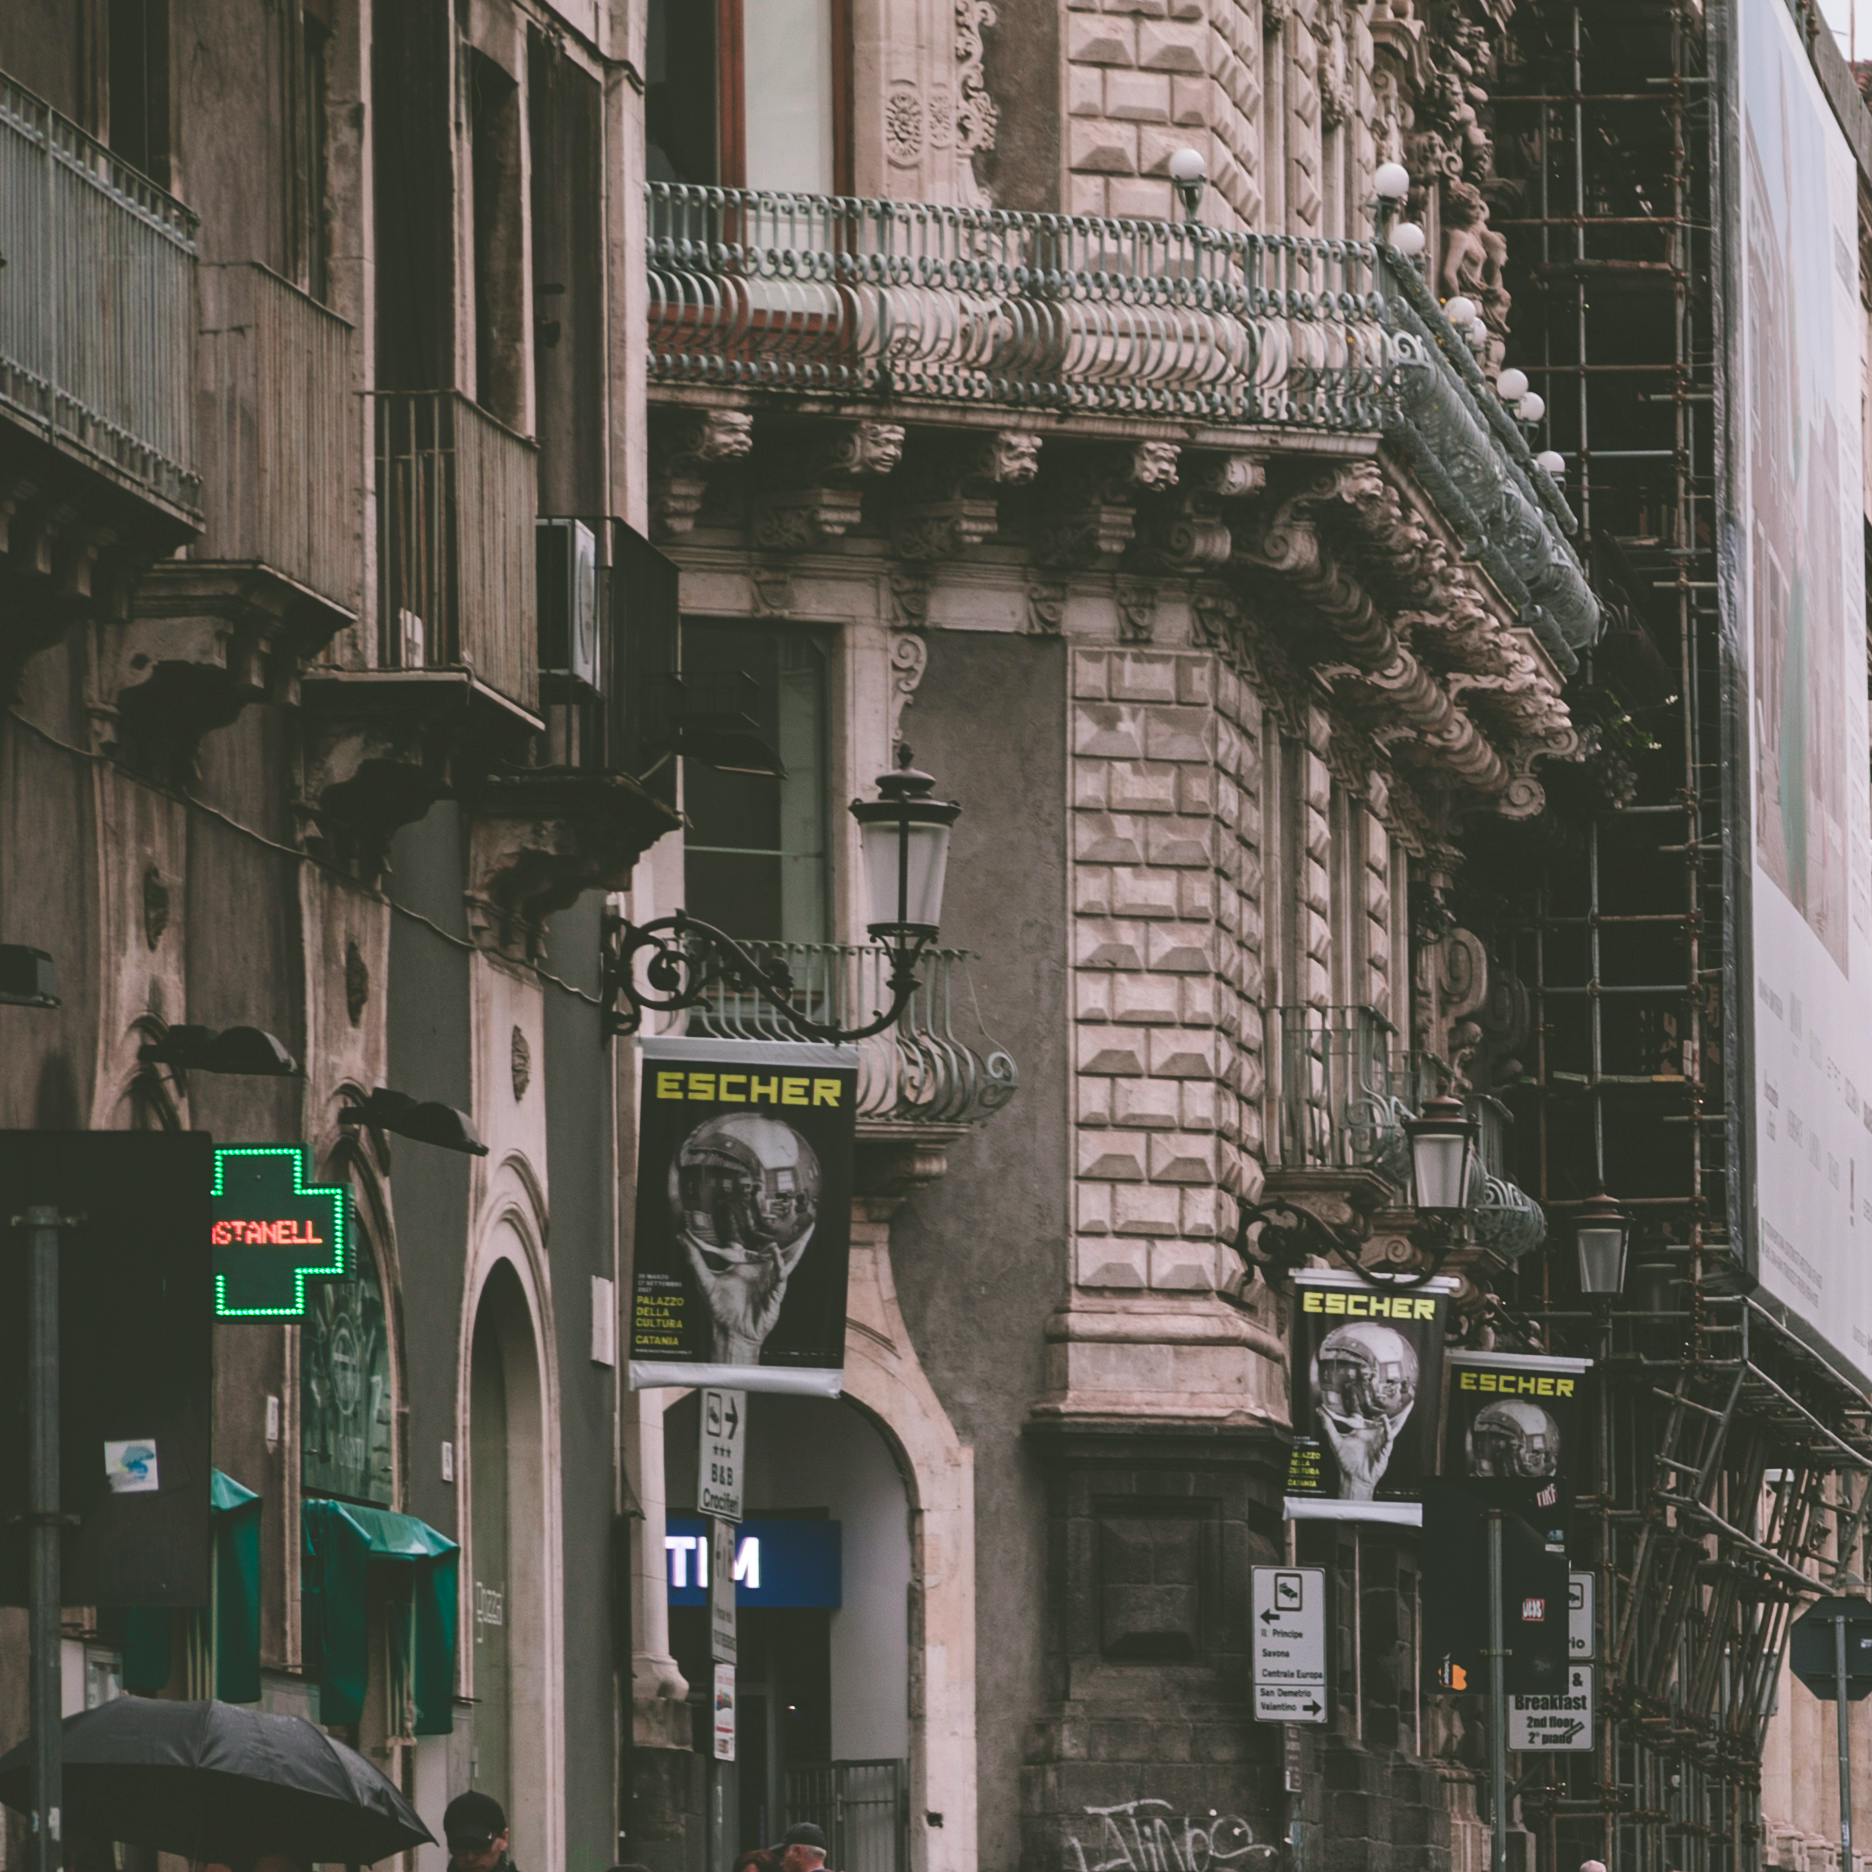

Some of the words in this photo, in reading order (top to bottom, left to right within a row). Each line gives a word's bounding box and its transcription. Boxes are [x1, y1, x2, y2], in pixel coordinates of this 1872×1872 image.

[656, 1071, 842, 1107] ESCHER
[636, 1295, 684, 1306] PALAZZO
[1303, 1291, 1435, 1320] ESCHER
[636, 1306, 670, 1317] DELLA
[636, 1318, 683, 1328] CULTURA
[635, 1335, 679, 1345] CATANIA
[1460, 1372, 1575, 1397] ESCHER
[711, 1463, 733, 1486] B&B
[1272, 1629, 1304, 1640] Principe
[1262, 1648, 1290, 1658] Savona
[1262, 1668, 1295, 1679] Centrale
[1296, 1669, 1323, 1681] Europa
[1260, 1688, 1275, 1698] San
[1277, 1688, 1312, 1698] Demetrio
[1260, 1702, 1297, 1712] Valentino
[1514, 1695, 1587, 1711] Breakfast
[1526, 1716, 1547, 1729] 2nd
[1549, 1716, 1575, 1729] floor
